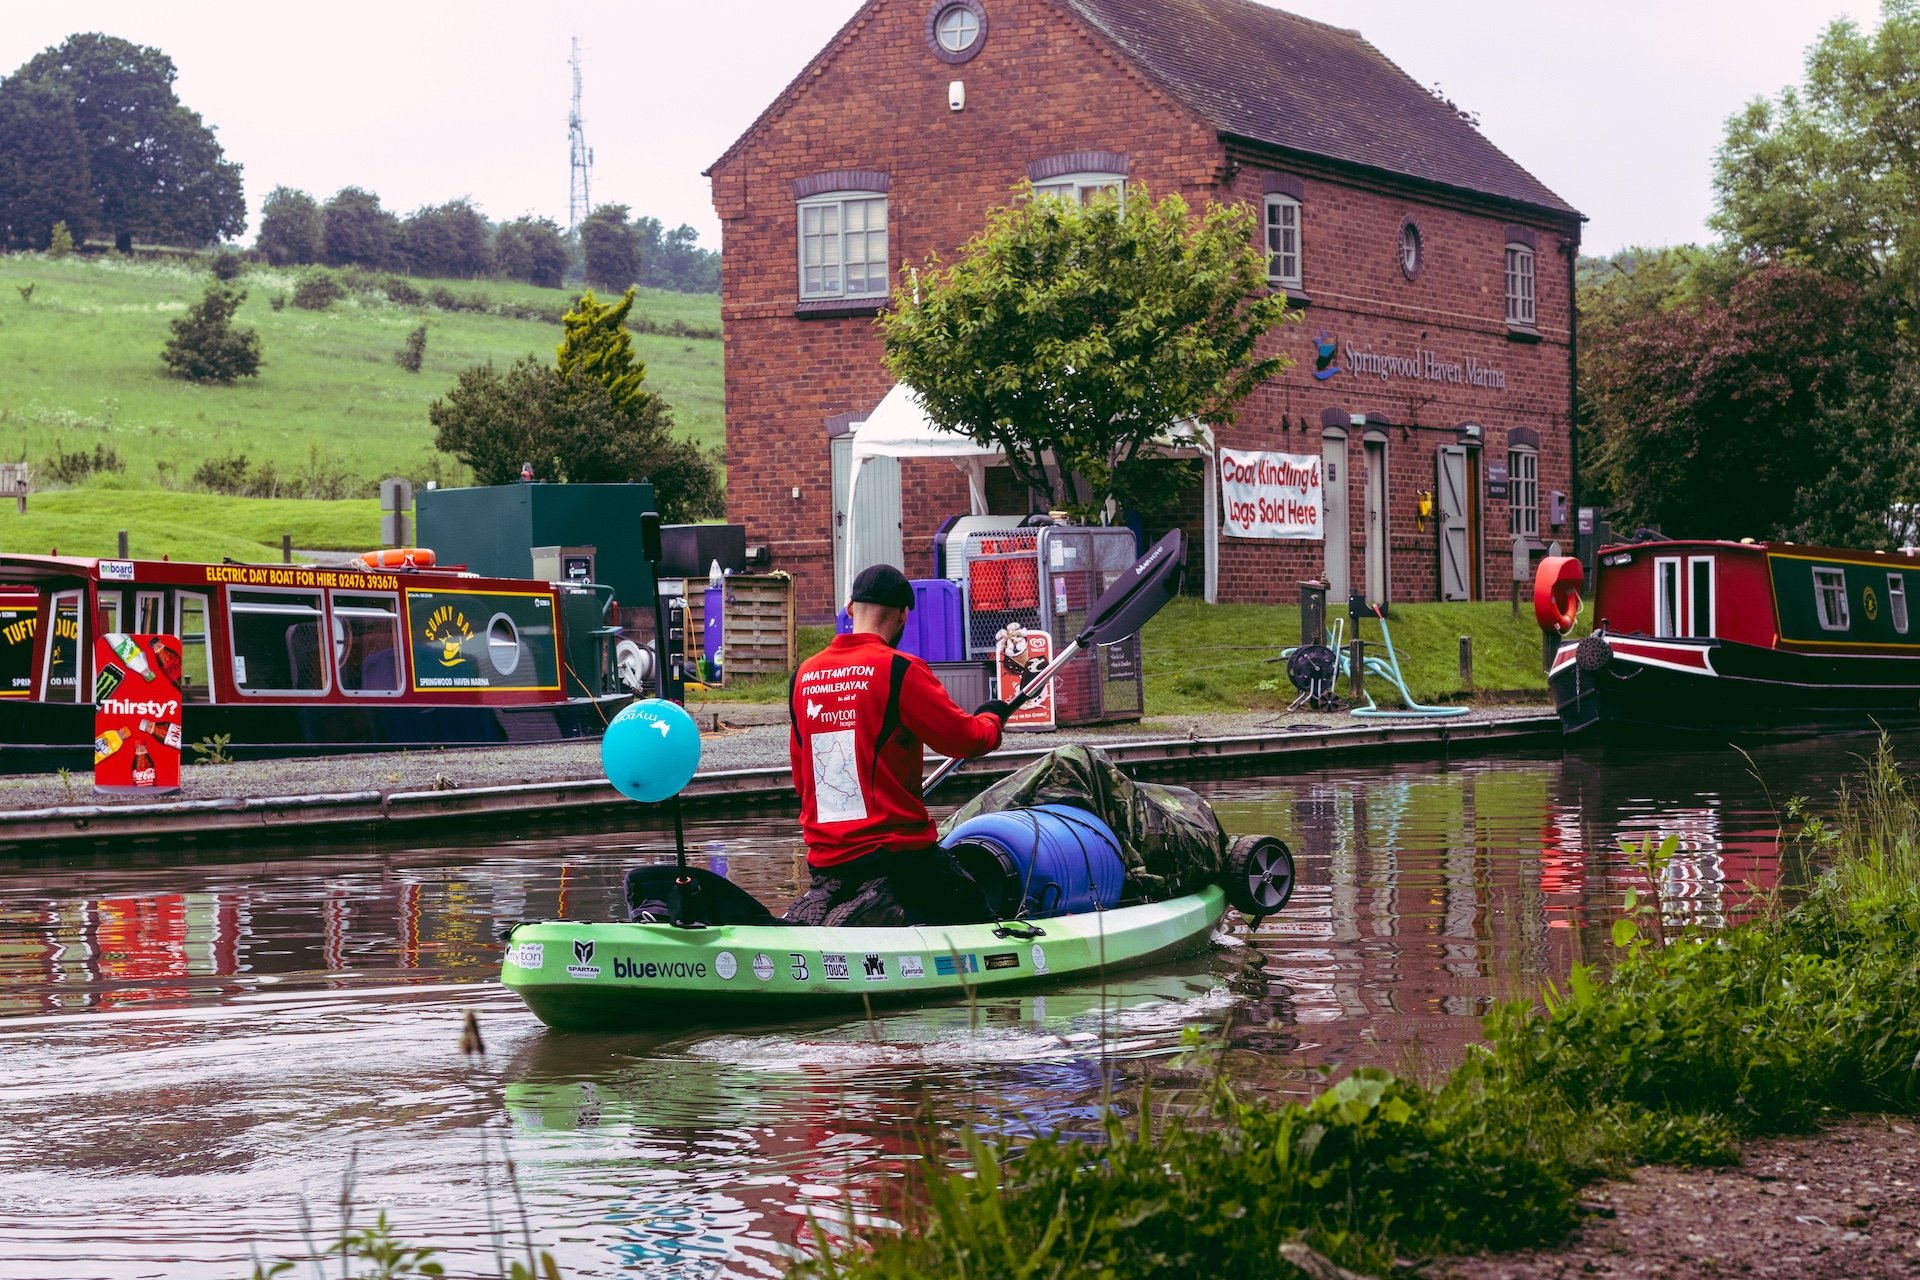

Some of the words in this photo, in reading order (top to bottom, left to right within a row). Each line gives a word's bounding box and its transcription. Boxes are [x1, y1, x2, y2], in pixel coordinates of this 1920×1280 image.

[1345, 340, 1421, 381] Springwood
[1424, 350, 1462, 383] Haven
[1465, 356, 1506, 389] Marina
[1258, 459, 1309, 495] Kindling
[1310, 462, 1319, 488] &
[1228, 496, 1256, 530] Logs
[1258, 497, 1285, 525] Sold
[1288, 499, 1317, 525] Here
[205, 567, 248, 583] ELECTRIC
[249, 568, 268, 584] DAY
[270, 570, 294, 586] BOAT
[296, 571, 315, 586] FOR
[317, 572, 337, 588] HIRE
[338, 574, 365, 589] 02476
[367, 575, 399, 590] 393676
[425, 605, 454, 641] SUNNY
[456, 612, 475, 642] DAY
[419, 677, 453, 687] SPRINGWOOD
[453, 677, 470, 687] HAVEN
[471, 677, 490, 687] MARINA
[802, 666, 874, 683] #MATT4MYTON
[802, 681, 868, 696] #100MILEKAYAK
[100, 698, 178, 719] Thirsty?
[821, 708, 856, 725] myton
[613, 957, 707, 979] bluewave
[822, 954, 847, 963] SPORTING
[824, 964, 849, 976] TOUCH
